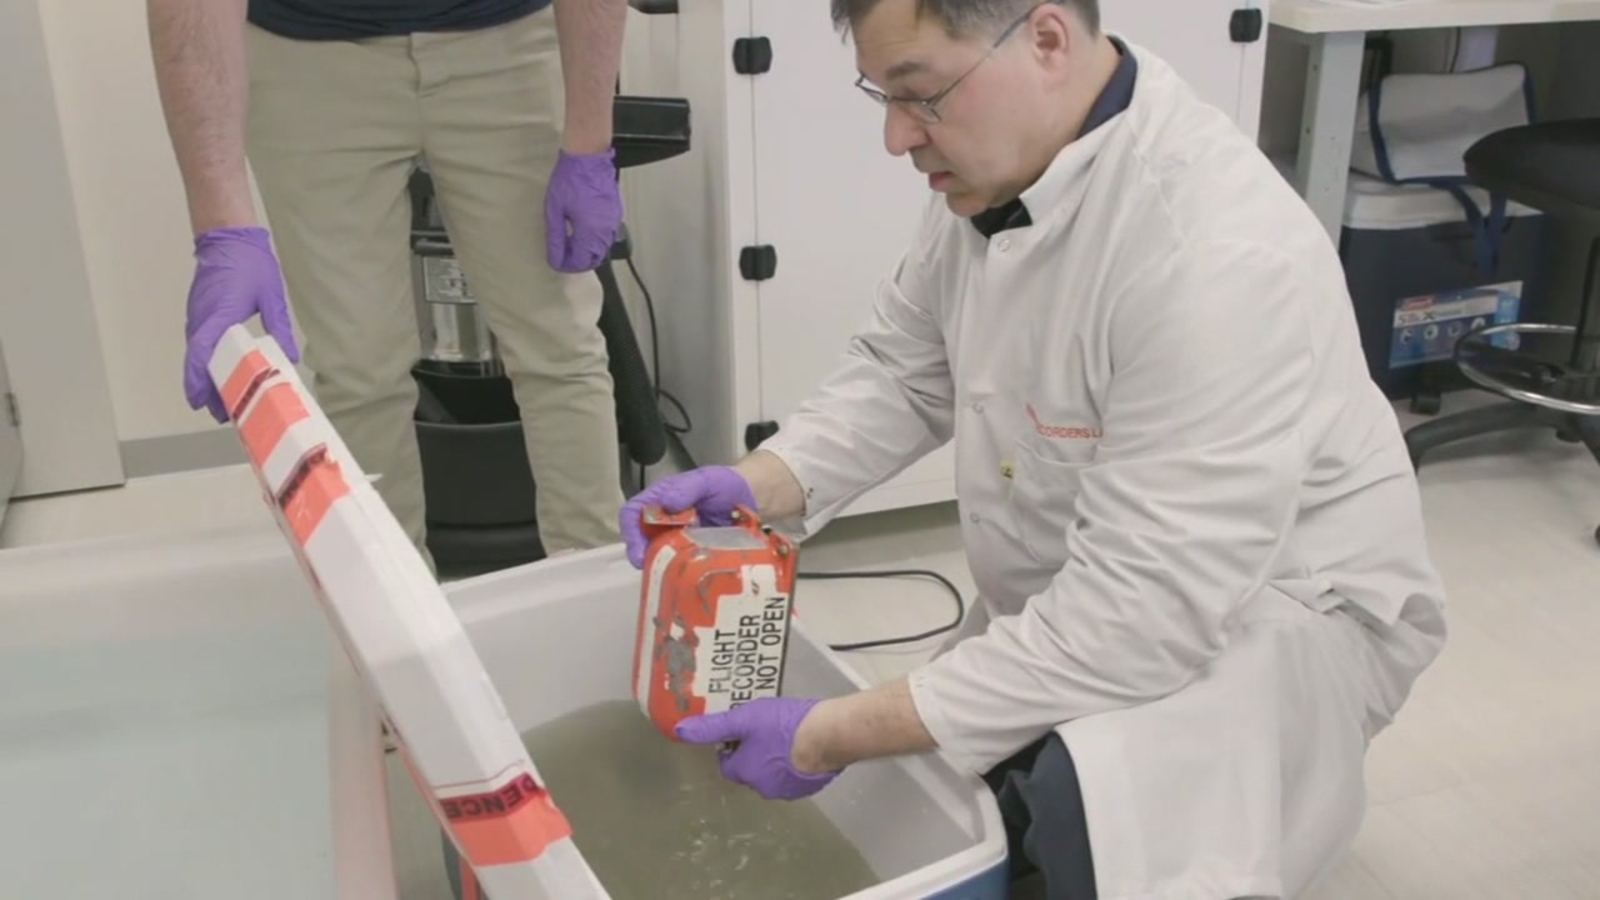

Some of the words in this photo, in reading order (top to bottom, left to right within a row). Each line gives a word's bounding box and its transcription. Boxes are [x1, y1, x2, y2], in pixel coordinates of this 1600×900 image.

[760, 597, 786, 646] OPEN
[708, 630, 736, 693] FLIGHT
[755, 653, 779, 690] NOT
